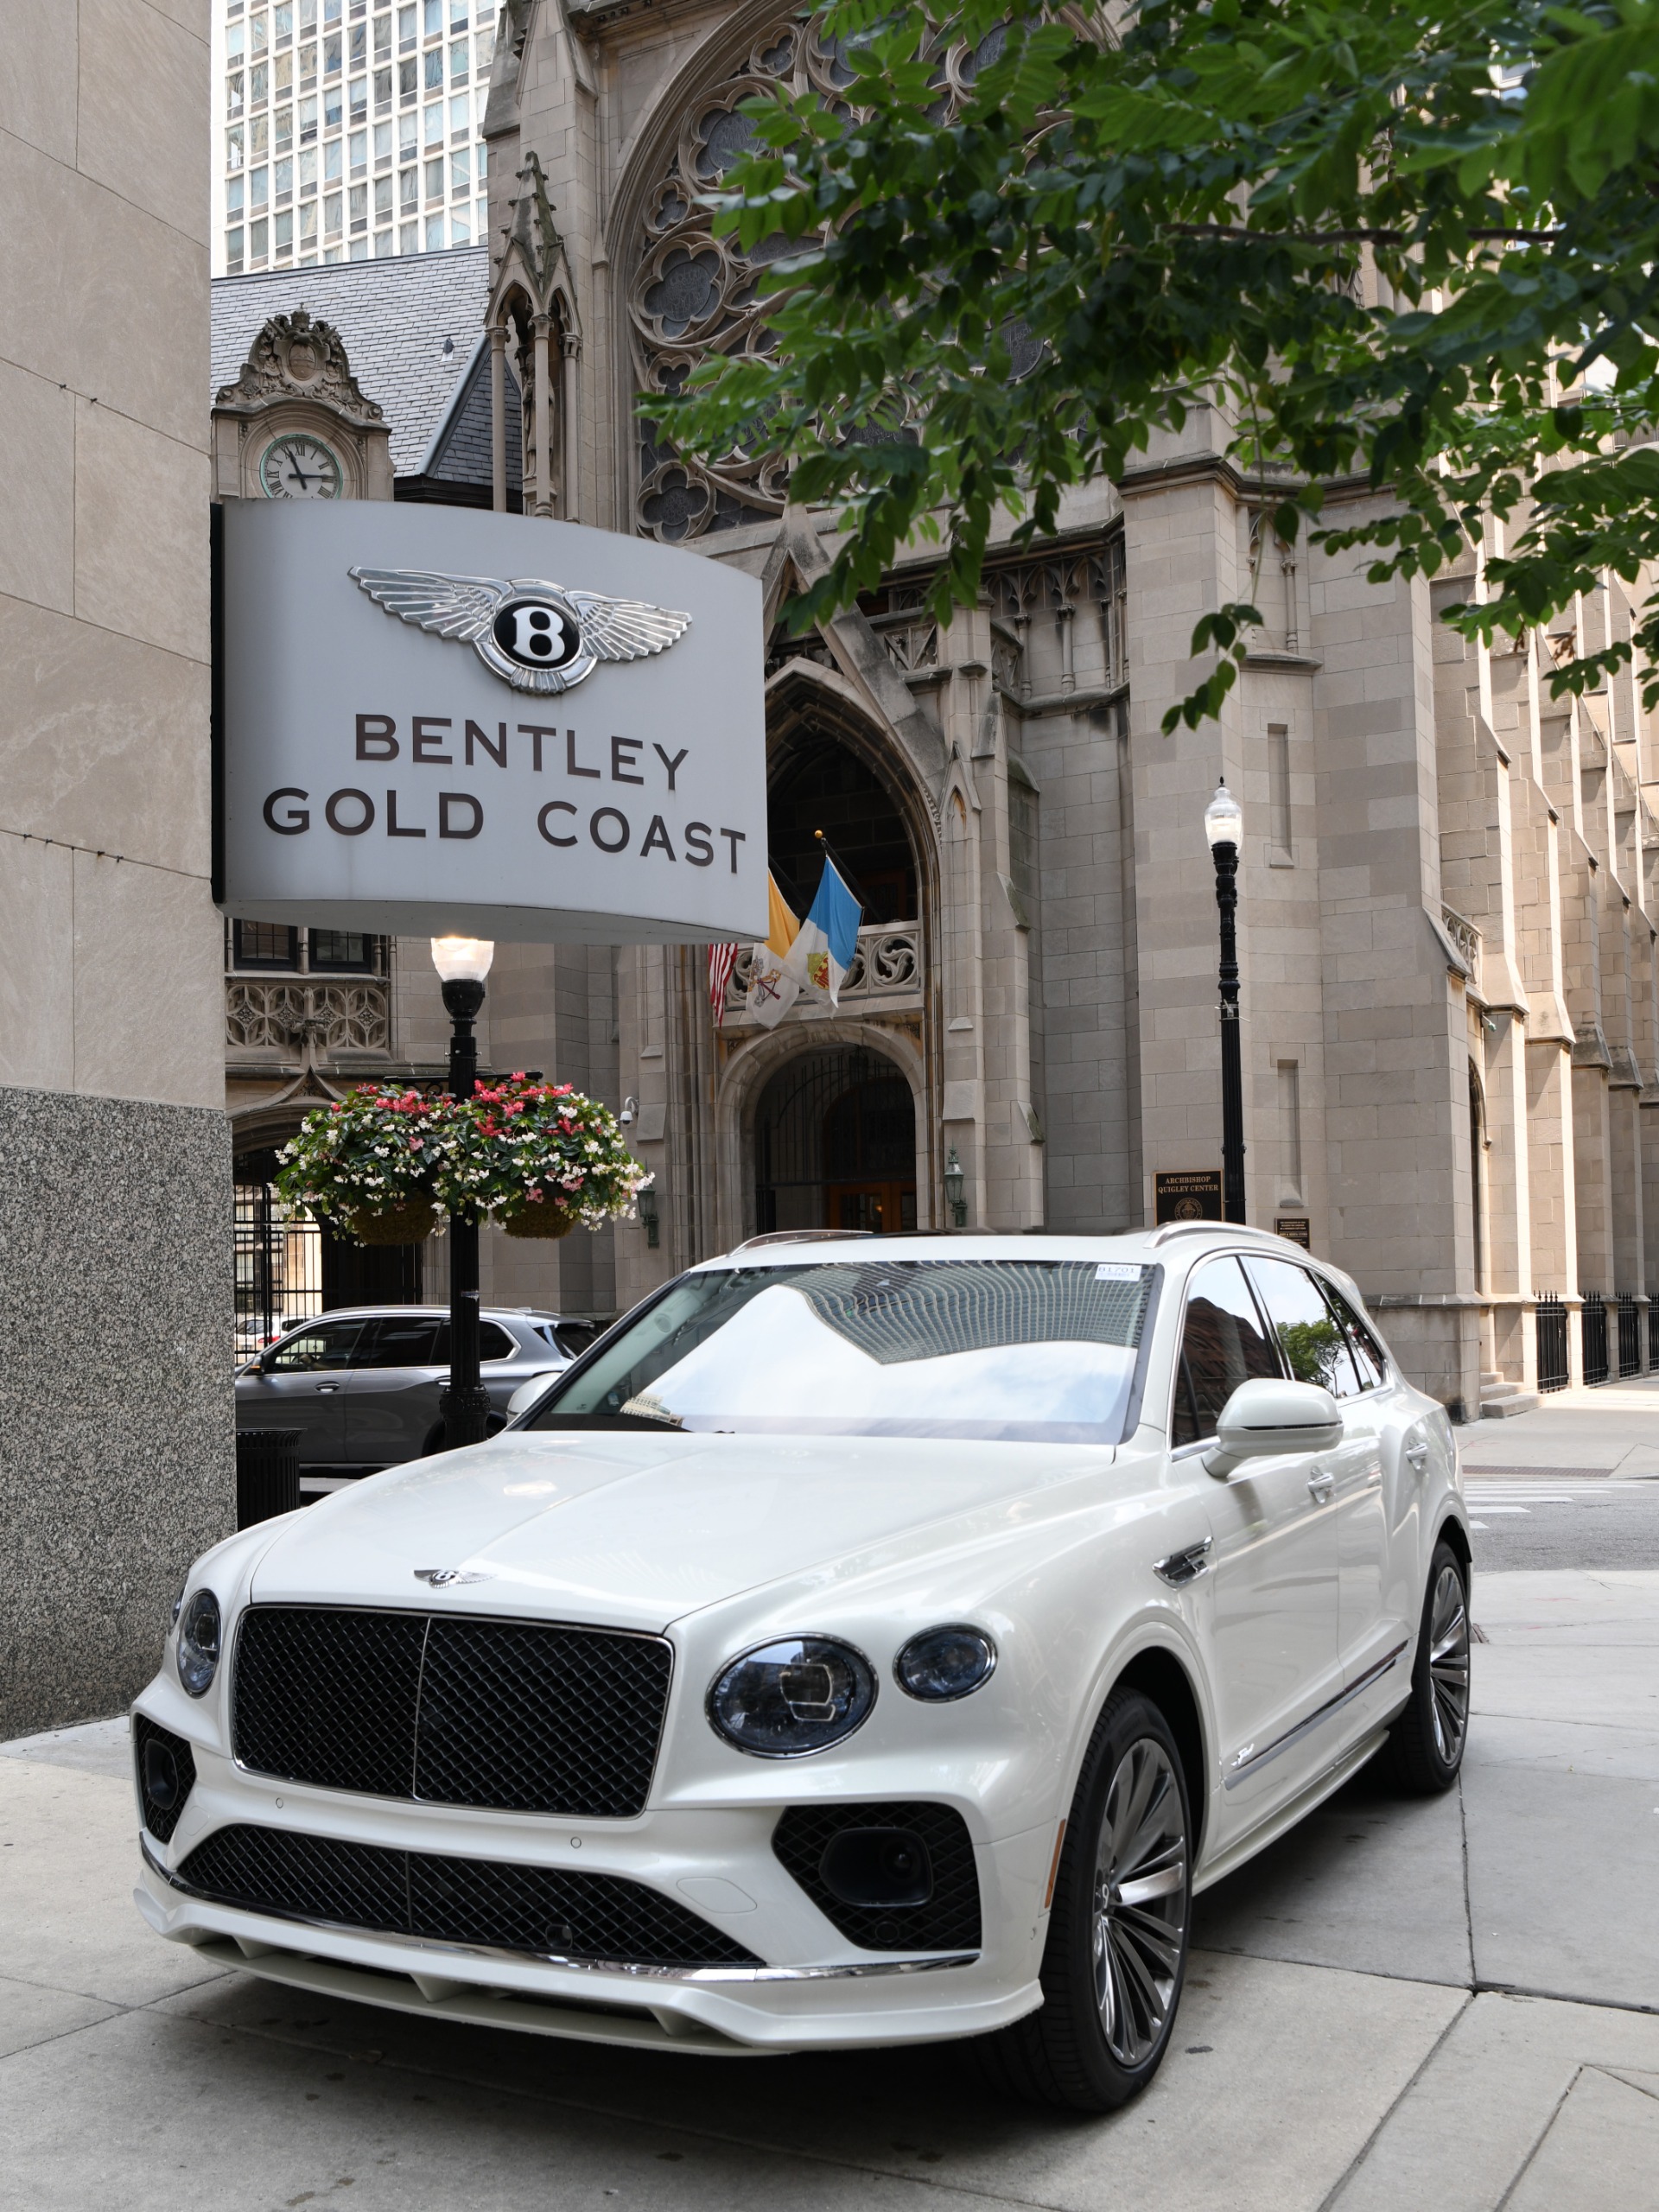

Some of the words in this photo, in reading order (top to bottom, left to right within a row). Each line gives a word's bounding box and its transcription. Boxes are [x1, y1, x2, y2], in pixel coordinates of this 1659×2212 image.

[355, 713, 690, 791] BENTLEY
[262, 787, 485, 840] GOLD
[537, 800, 747, 874] COAST
[1158, 1185, 1189, 1194] QUIGLEY
